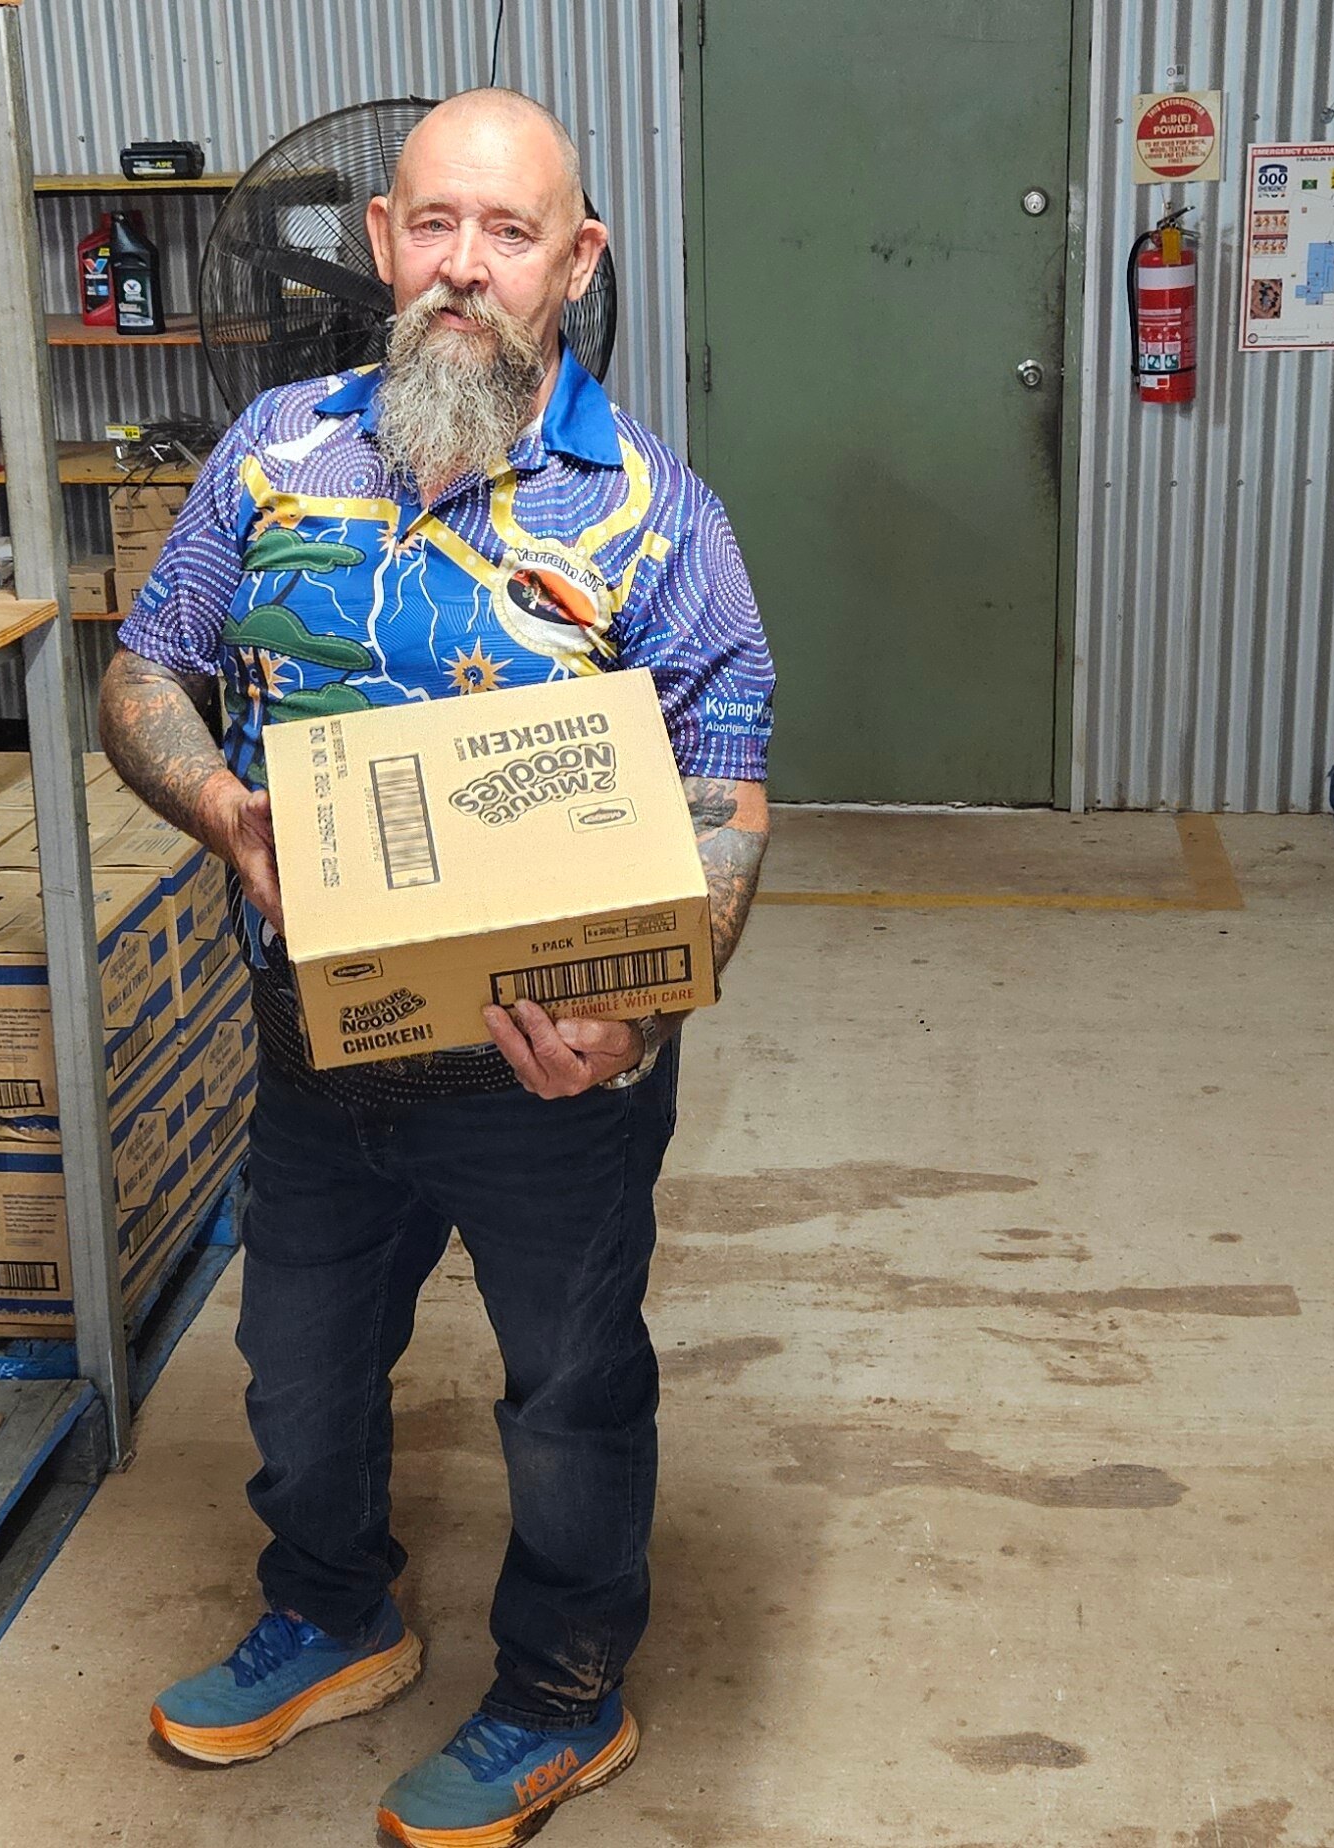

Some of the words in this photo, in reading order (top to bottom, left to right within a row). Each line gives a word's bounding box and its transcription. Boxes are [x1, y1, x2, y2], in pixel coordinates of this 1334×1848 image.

[1153, 124, 1199, 136] POWDER
[1259, 173, 1288, 186] 000
[515, 548, 579, 580] Yarralin
[580, 569, 604, 593] NT
[452, 744, 613, 814] Noodles
[592, 771, 612, 790] 2
[483, 773, 590, 824] Minute
[532, 943, 539, 954] 5
[542, 937, 575, 953] PACK
[342, 1006, 355, 1019] 2
[354, 988, 409, 1020] Minute
[342, 994, 426, 1034] Noodles
[572, 1003, 620, 1019] HANDLE
[625, 997, 657, 1010] WITH
[661, 988, 696, 1002] CARE
[343, 1024, 434, 1054] CHICKEN!
[512, 1748, 580, 1808] HOKA
